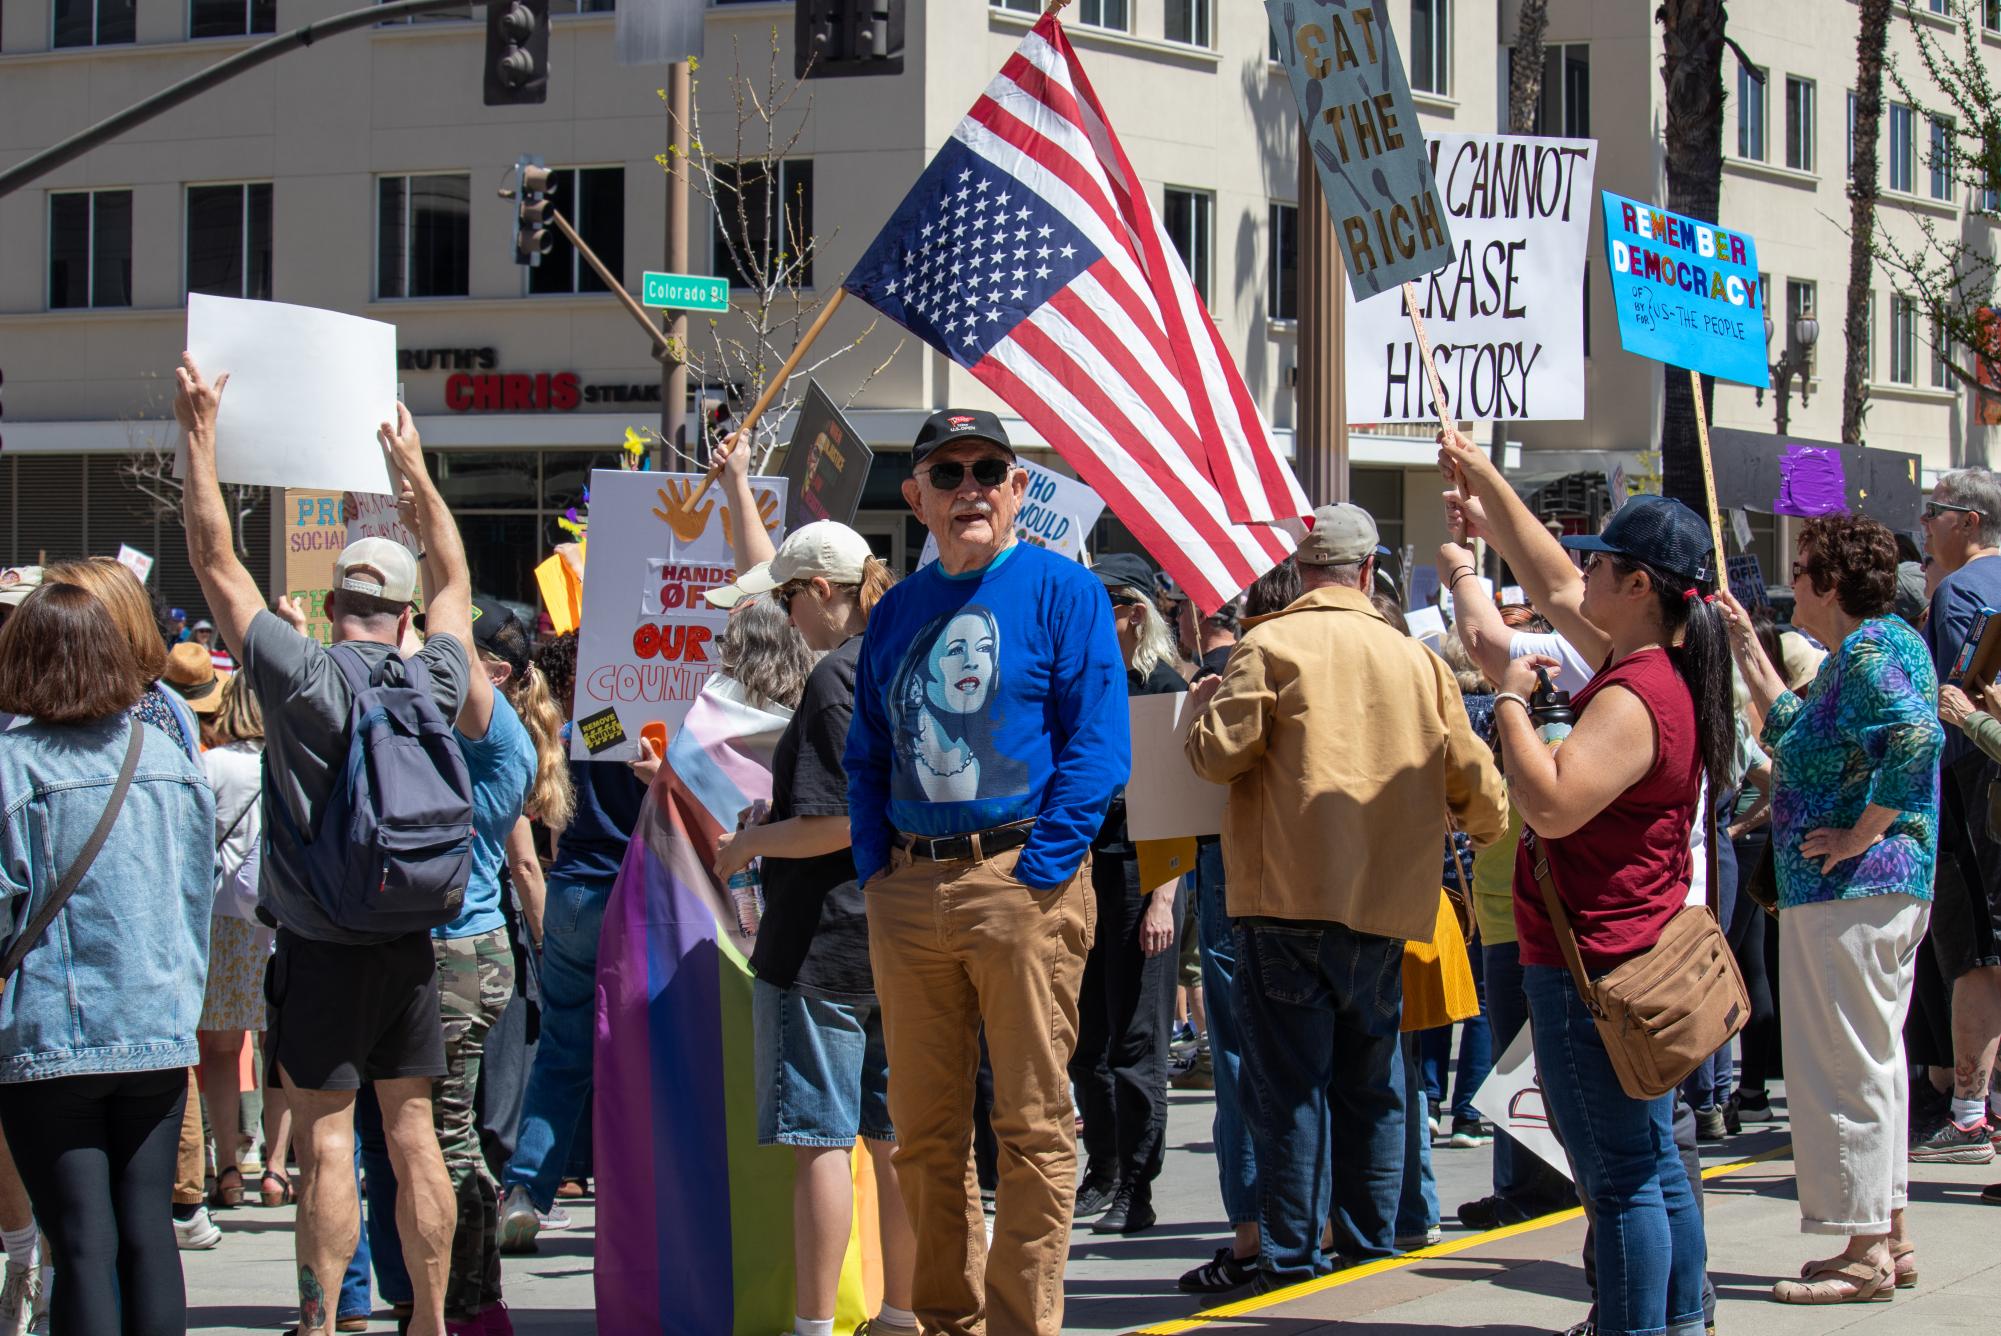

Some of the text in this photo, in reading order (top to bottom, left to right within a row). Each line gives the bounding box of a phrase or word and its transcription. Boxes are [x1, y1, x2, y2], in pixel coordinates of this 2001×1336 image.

[1296, 7, 1378, 80] EAT
[1322, 92, 1405, 164] THE
[1447, 140, 1589, 222] CANNOT
[1343, 190, 1445, 275] RICH
[1621, 201, 1747, 266] REMEMBER
[649, 280, 706, 302] Colorado
[1612, 239, 1757, 309] DEMOCRACY
[1631, 286, 1643, 298] OF
[1634, 302, 1645, 312] BY
[1636, 313, 1650, 325] FOR
[1703, 314, 1745, 341] PEOPLE
[445, 371, 580, 411] CHRIS
[584, 385, 662, 403] STEAK
[1383, 341, 1542, 420] HISTORY
[661, 565, 738, 584] HANDS
[632, 622, 713, 663] OUR
[586, 663, 719, 703] COUNT
